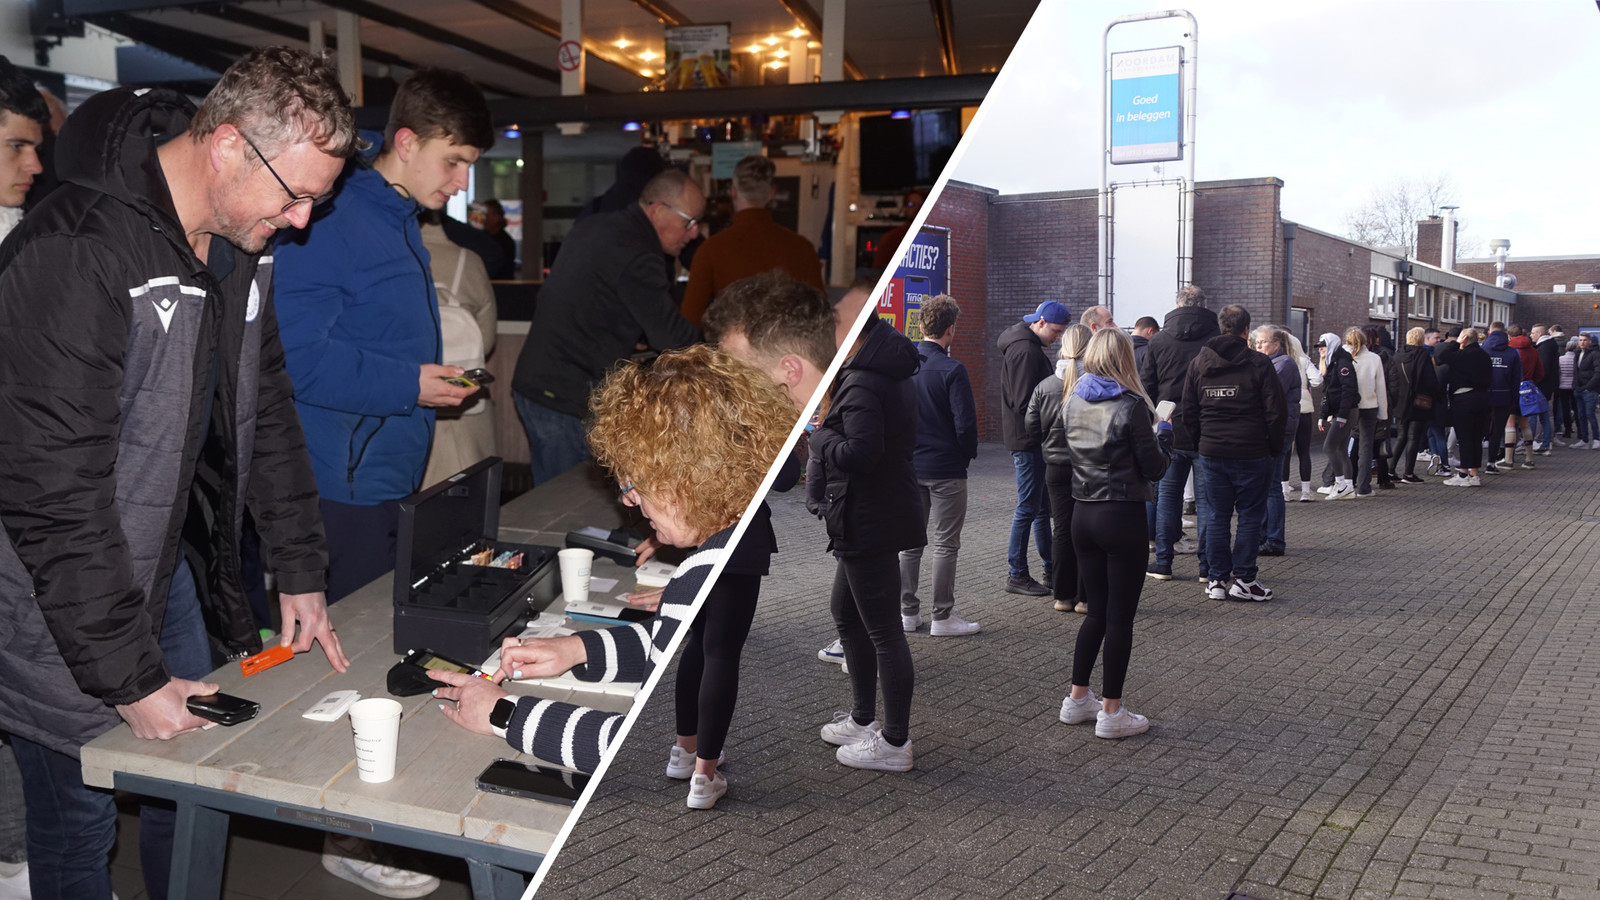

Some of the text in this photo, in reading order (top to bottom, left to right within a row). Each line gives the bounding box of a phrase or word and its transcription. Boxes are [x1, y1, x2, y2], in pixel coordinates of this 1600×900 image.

[1133, 93, 1159, 105] Goed
[1127, 110, 1171, 122] beleggen
[900, 244, 939, 270] ACTIES?
[1205, 388, 1236, 397] TRILO
